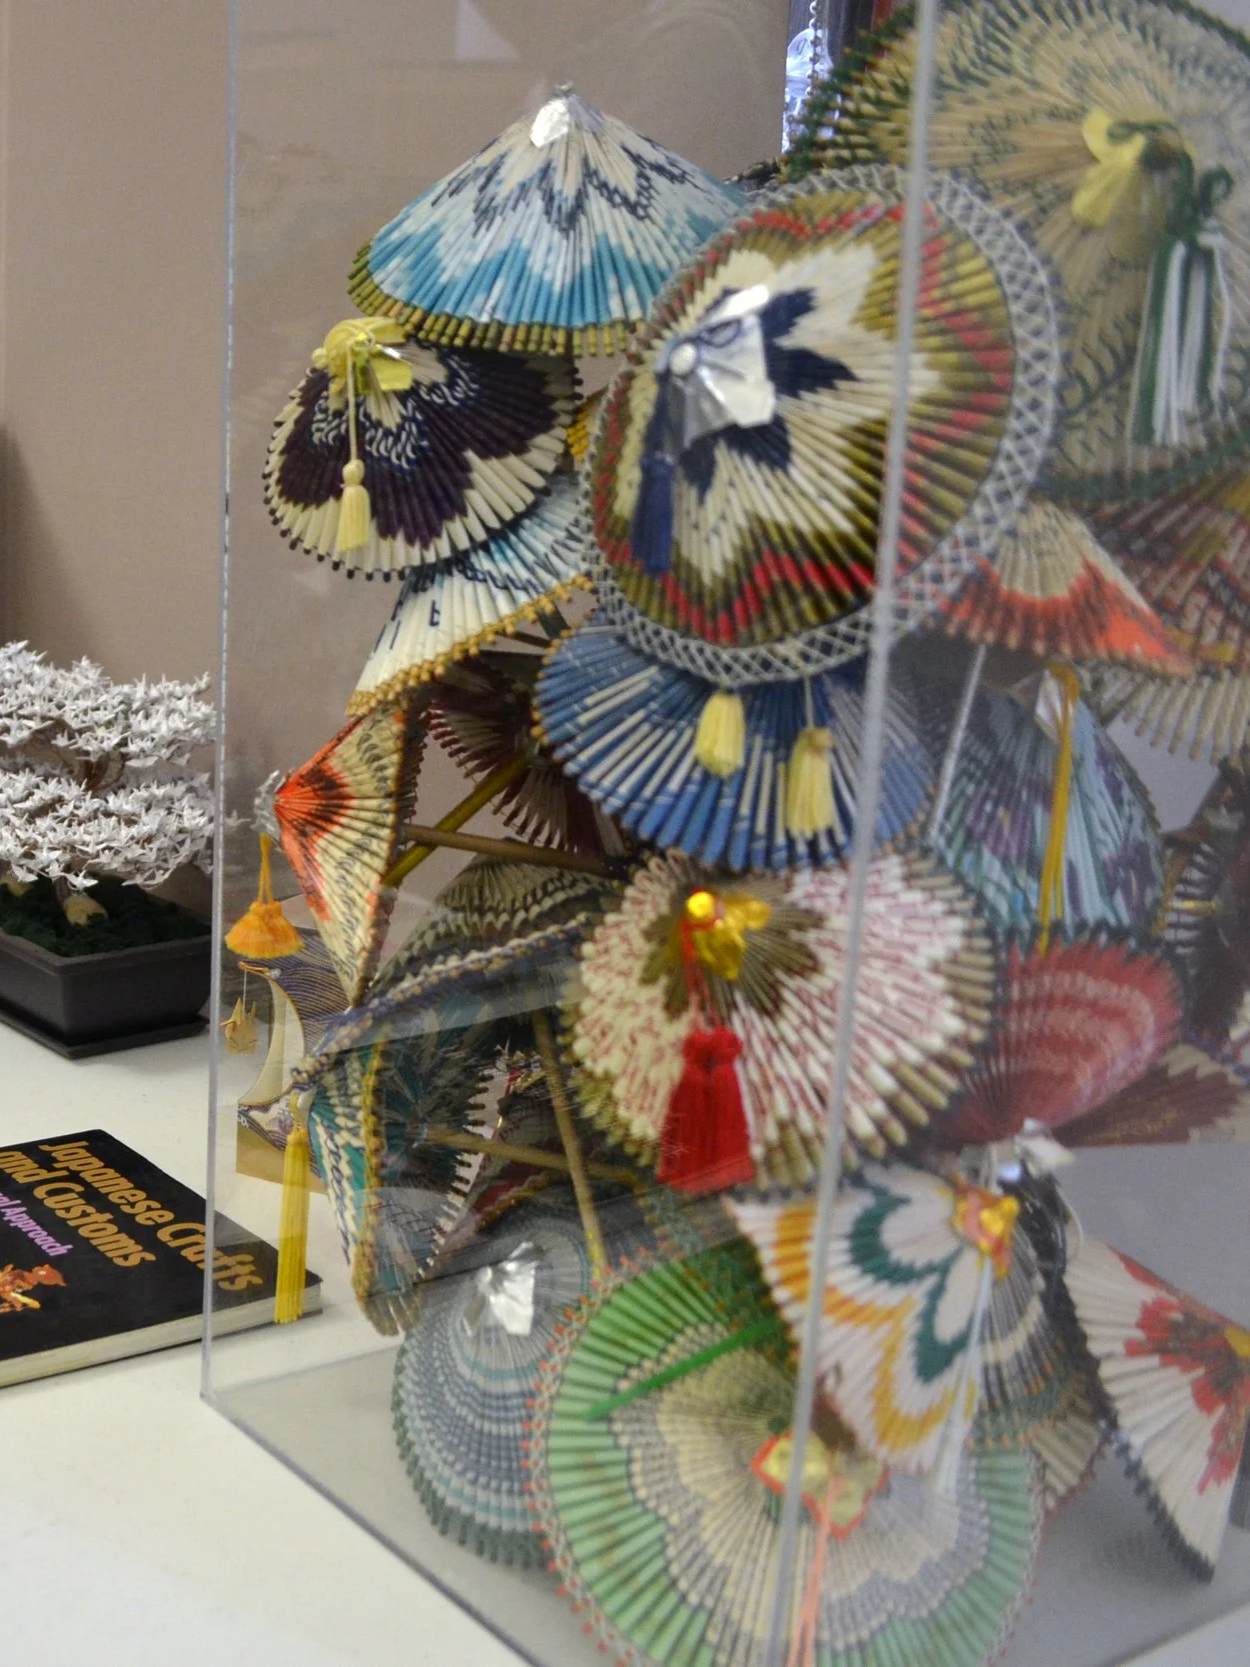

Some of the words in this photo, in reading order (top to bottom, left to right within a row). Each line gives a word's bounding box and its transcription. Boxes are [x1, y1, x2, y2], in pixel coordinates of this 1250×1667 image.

[33, 1181, 157, 1267] Customs
[39, 1140, 175, 1226] Japanese
[0, 1207, 74, 1257] Approach
